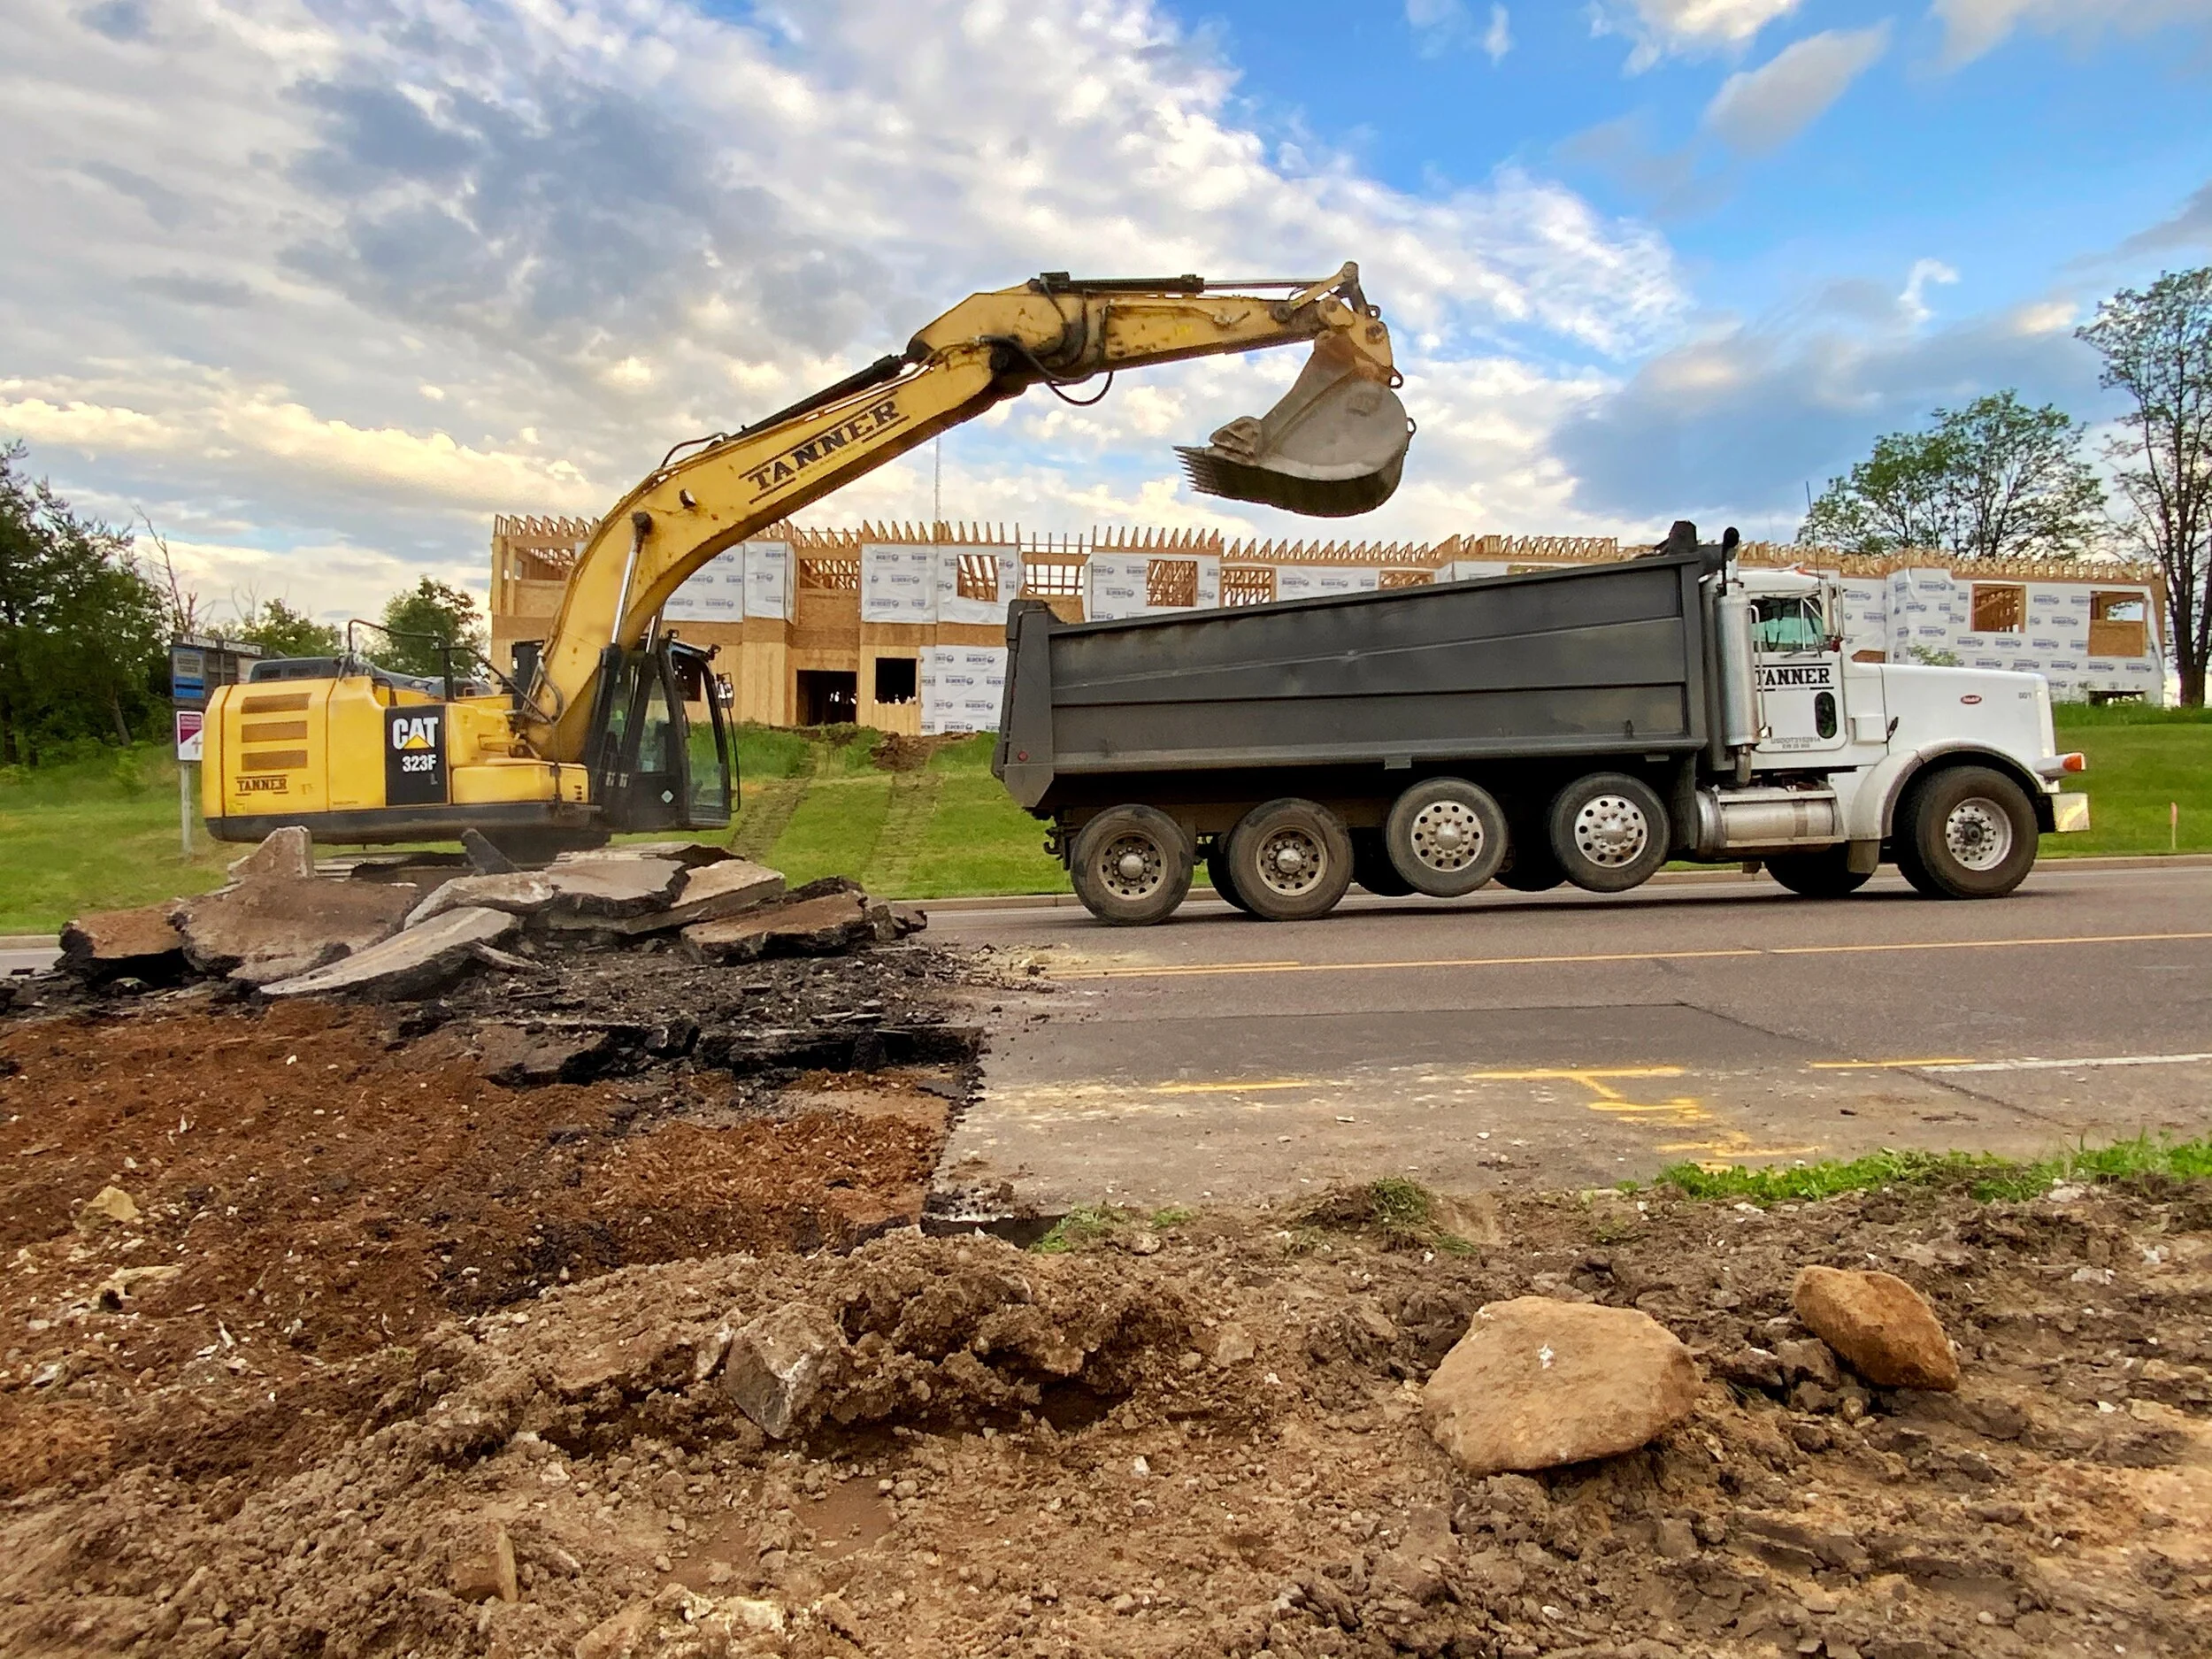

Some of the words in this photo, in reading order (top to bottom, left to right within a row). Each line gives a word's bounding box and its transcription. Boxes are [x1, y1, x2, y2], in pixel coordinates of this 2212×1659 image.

[749, 401, 901, 491] TANNER
[1755, 667, 1831, 686] TANNER
[392, 717, 439, 749] CAT
[402, 754, 436, 772] 323F
[237, 778, 288, 792] TANNER
